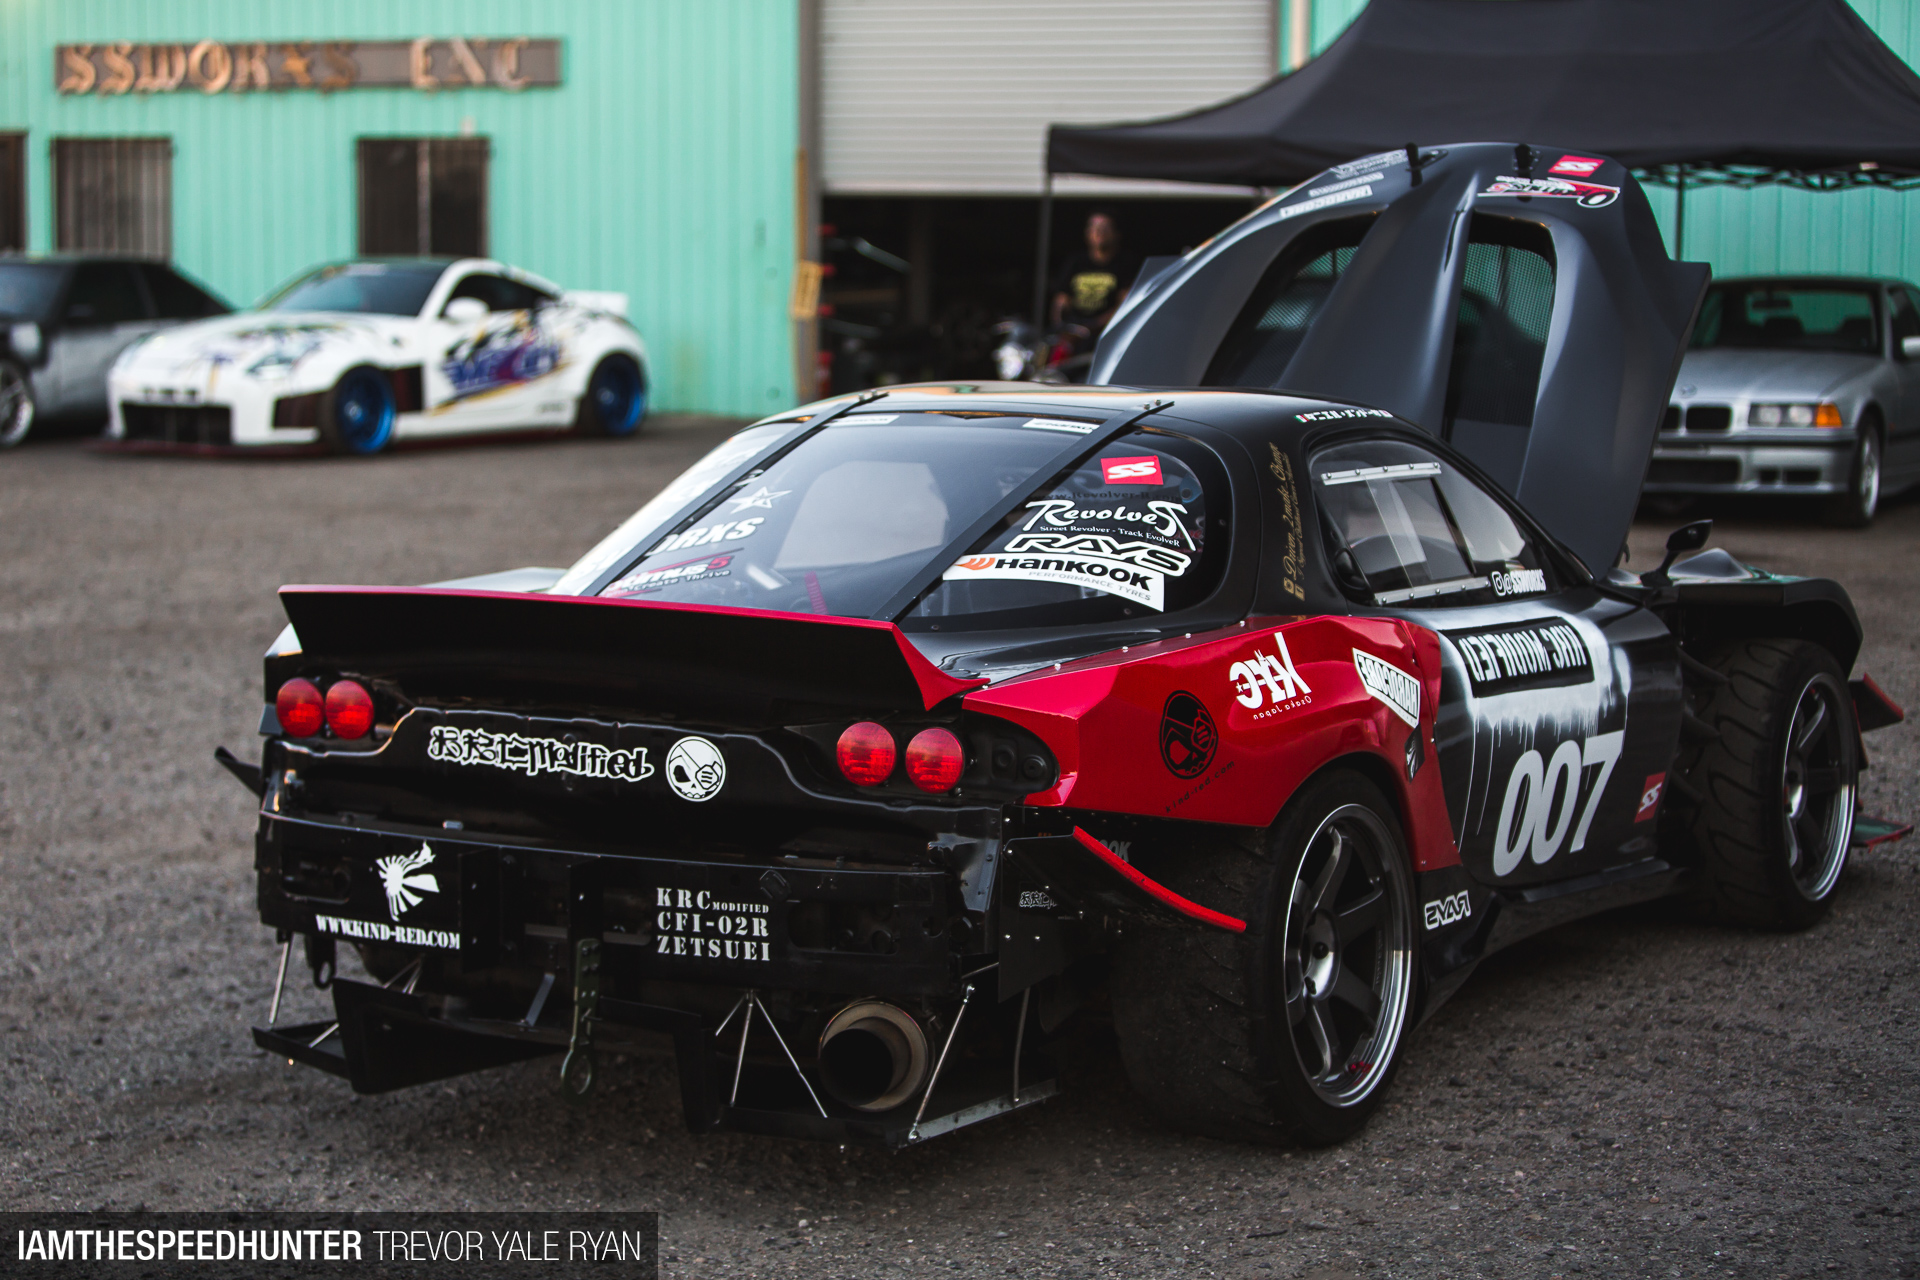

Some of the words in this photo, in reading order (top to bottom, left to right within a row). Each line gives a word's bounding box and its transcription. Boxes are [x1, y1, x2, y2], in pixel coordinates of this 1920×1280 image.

[1107, 461, 1157, 479] SS
[1070, 525, 1110, 533] Revolver
[1118, 527, 1143, 537] Track
[1004, 534, 1191, 577] RAYS
[1029, 572, 1113, 589] PERFORMANCE
[1118, 585, 1151, 601] TYRES
[1493, 730, 1624, 877] 007
[656, 887, 710, 910] KRC
[712, 901, 769, 914] MODIFIED
[657, 911, 769, 937] CFI-02R
[657, 935, 770, 961] ZETSUEI
